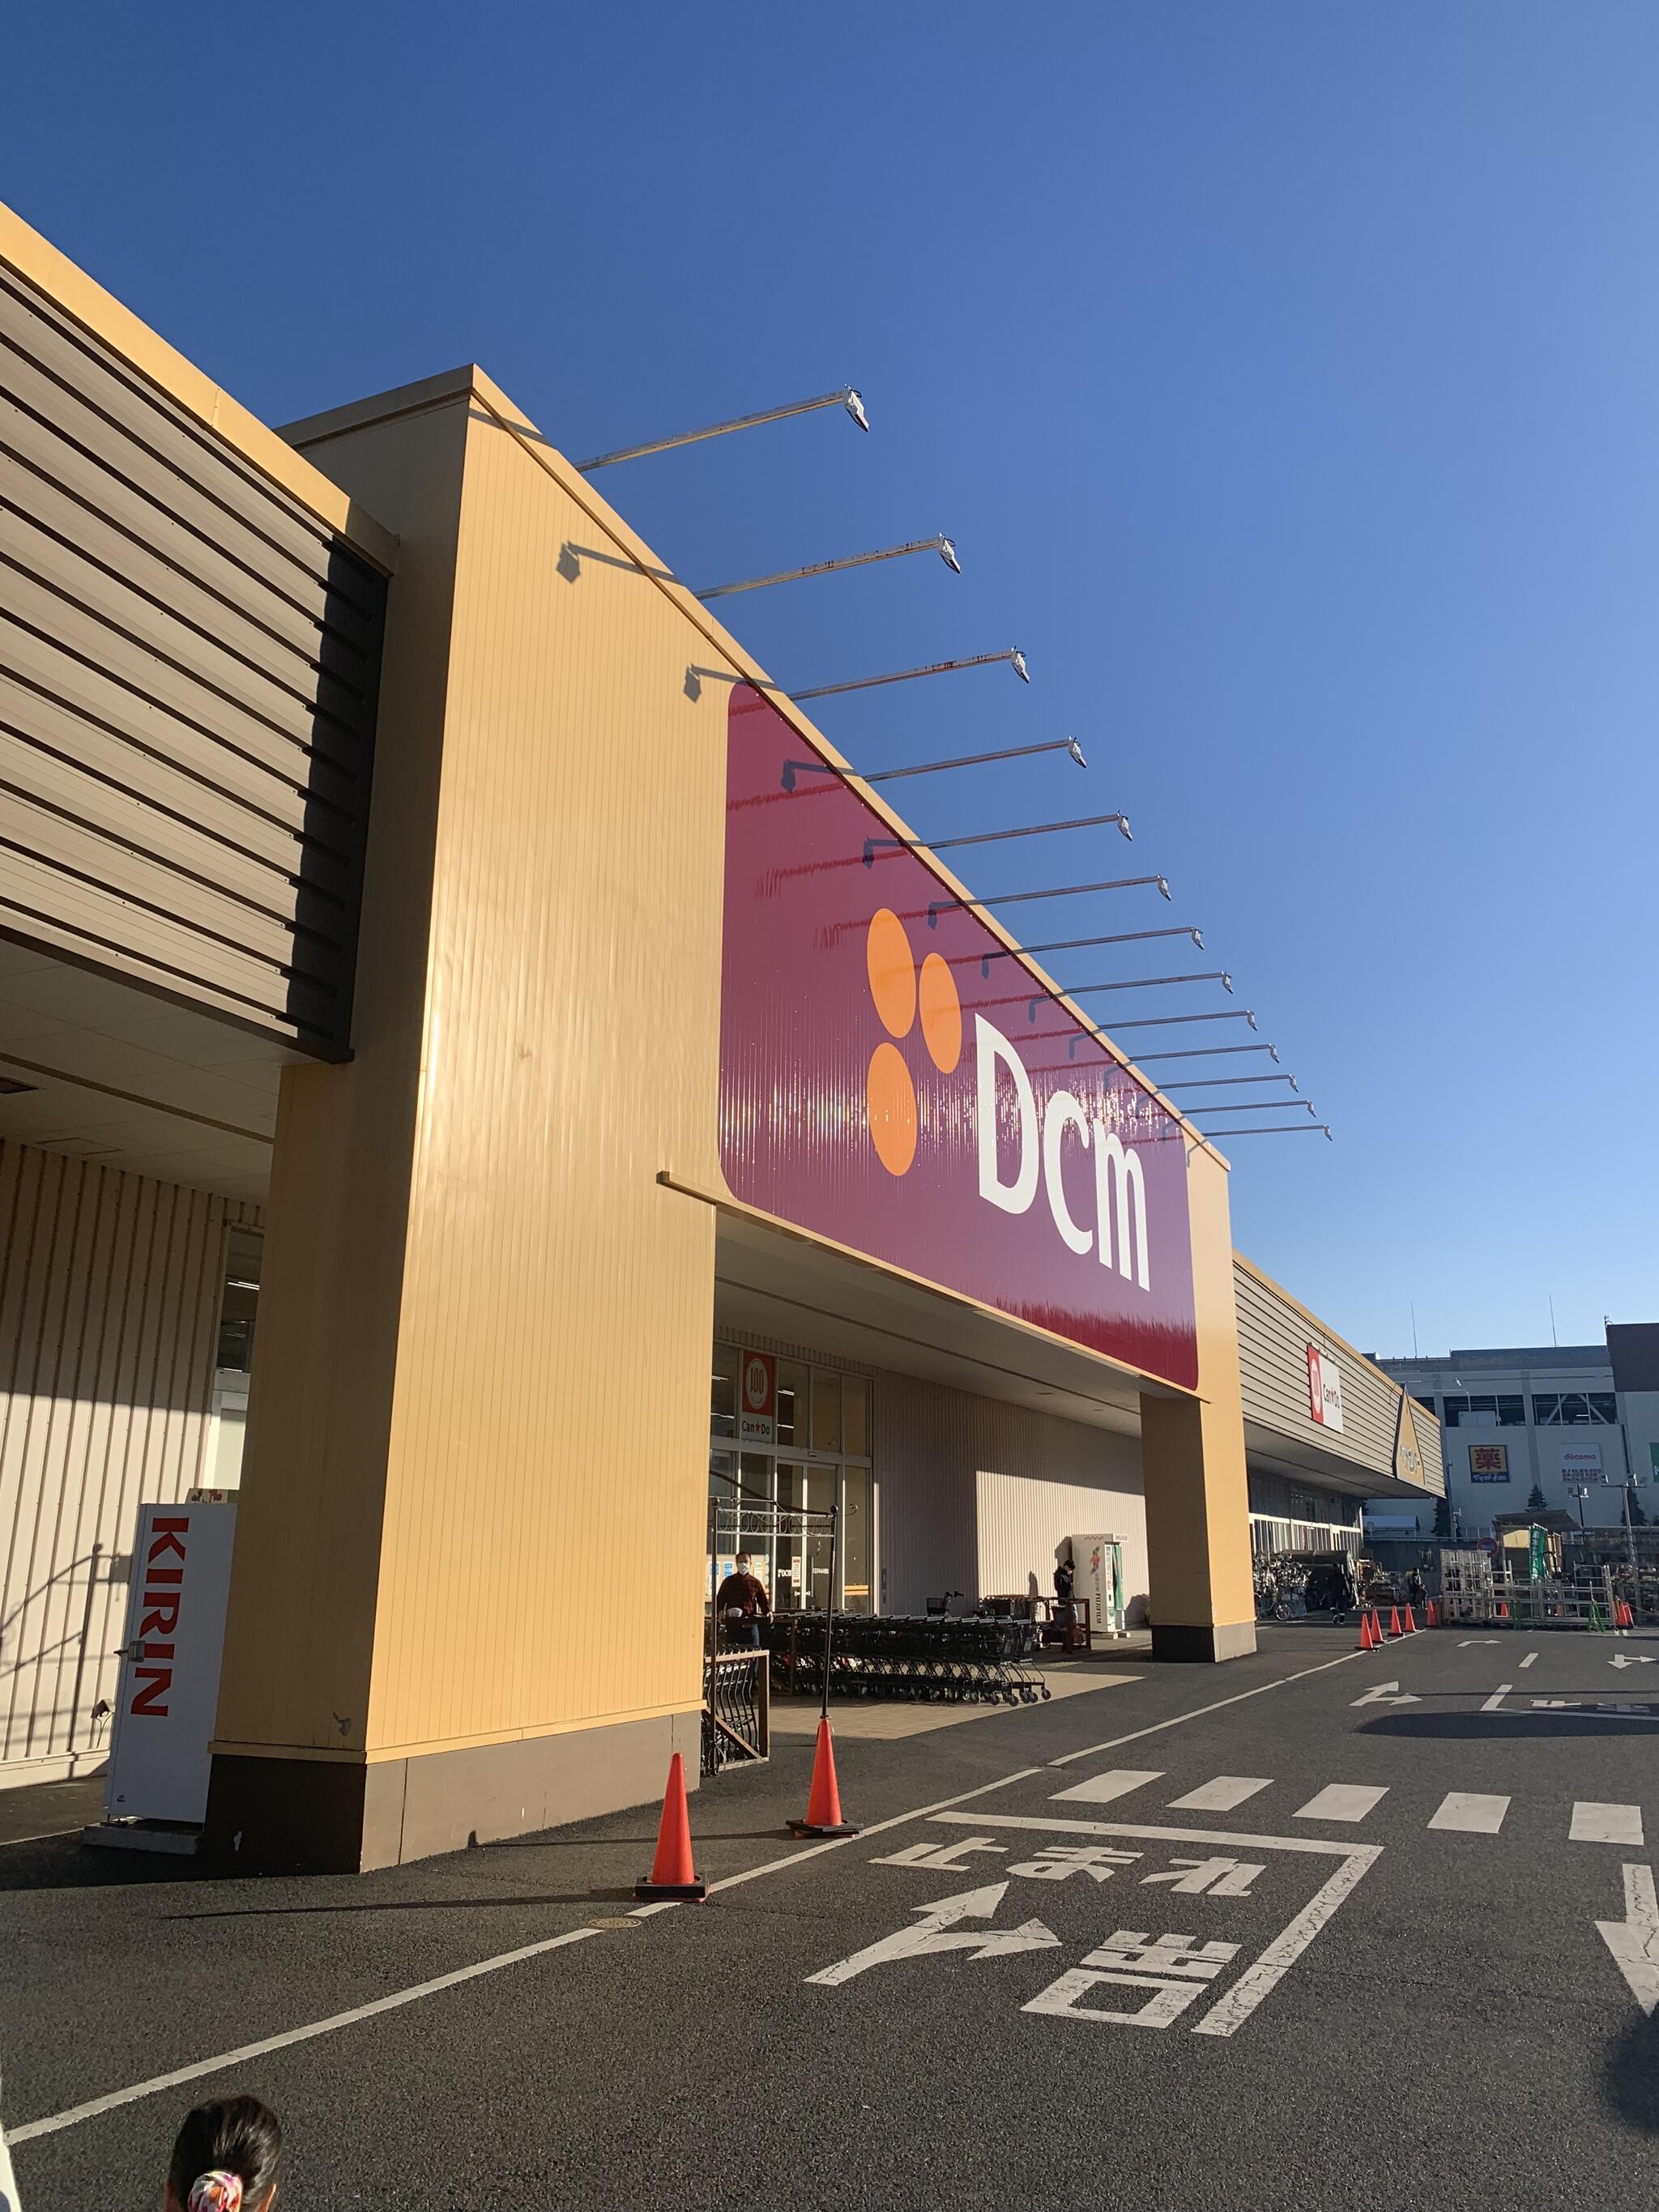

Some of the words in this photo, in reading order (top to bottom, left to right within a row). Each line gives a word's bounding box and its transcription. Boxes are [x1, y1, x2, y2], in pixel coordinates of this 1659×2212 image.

[750, 1367, 764, 1393] 100
[1474, 1448, 1501, 1470] 薬
[130, 1517, 190, 1717] KIRIN
[868, 1837, 1266, 1897] 止まれ
[1020, 1930, 1243, 2029] 出口
